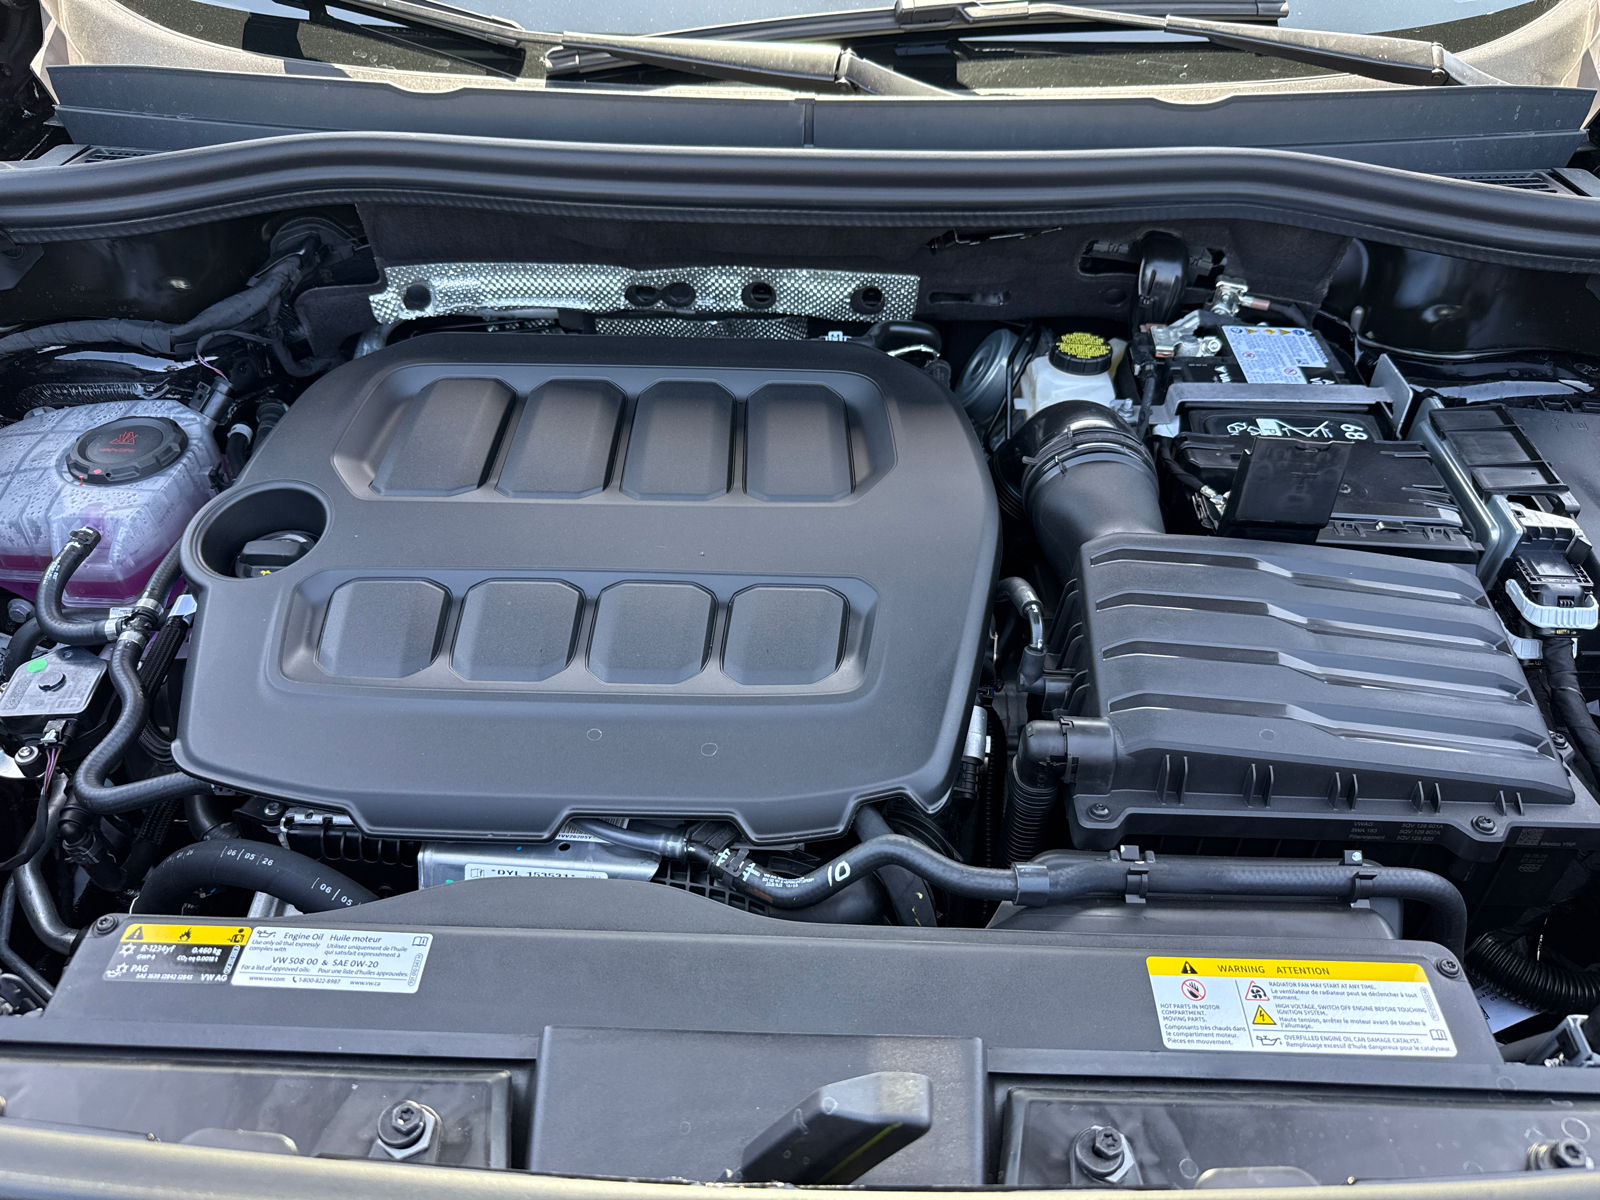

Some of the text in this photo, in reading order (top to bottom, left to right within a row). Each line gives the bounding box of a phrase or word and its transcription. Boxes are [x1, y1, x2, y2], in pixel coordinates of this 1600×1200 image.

[284, 932, 310, 941] Engine
[330, 934, 351, 942] Huile
[212, 948, 222, 956] kg
[130, 964, 149, 973] PAG
[1217, 964, 1265, 973] WARNING
[1276, 966, 1330, 975] ATTENTION
